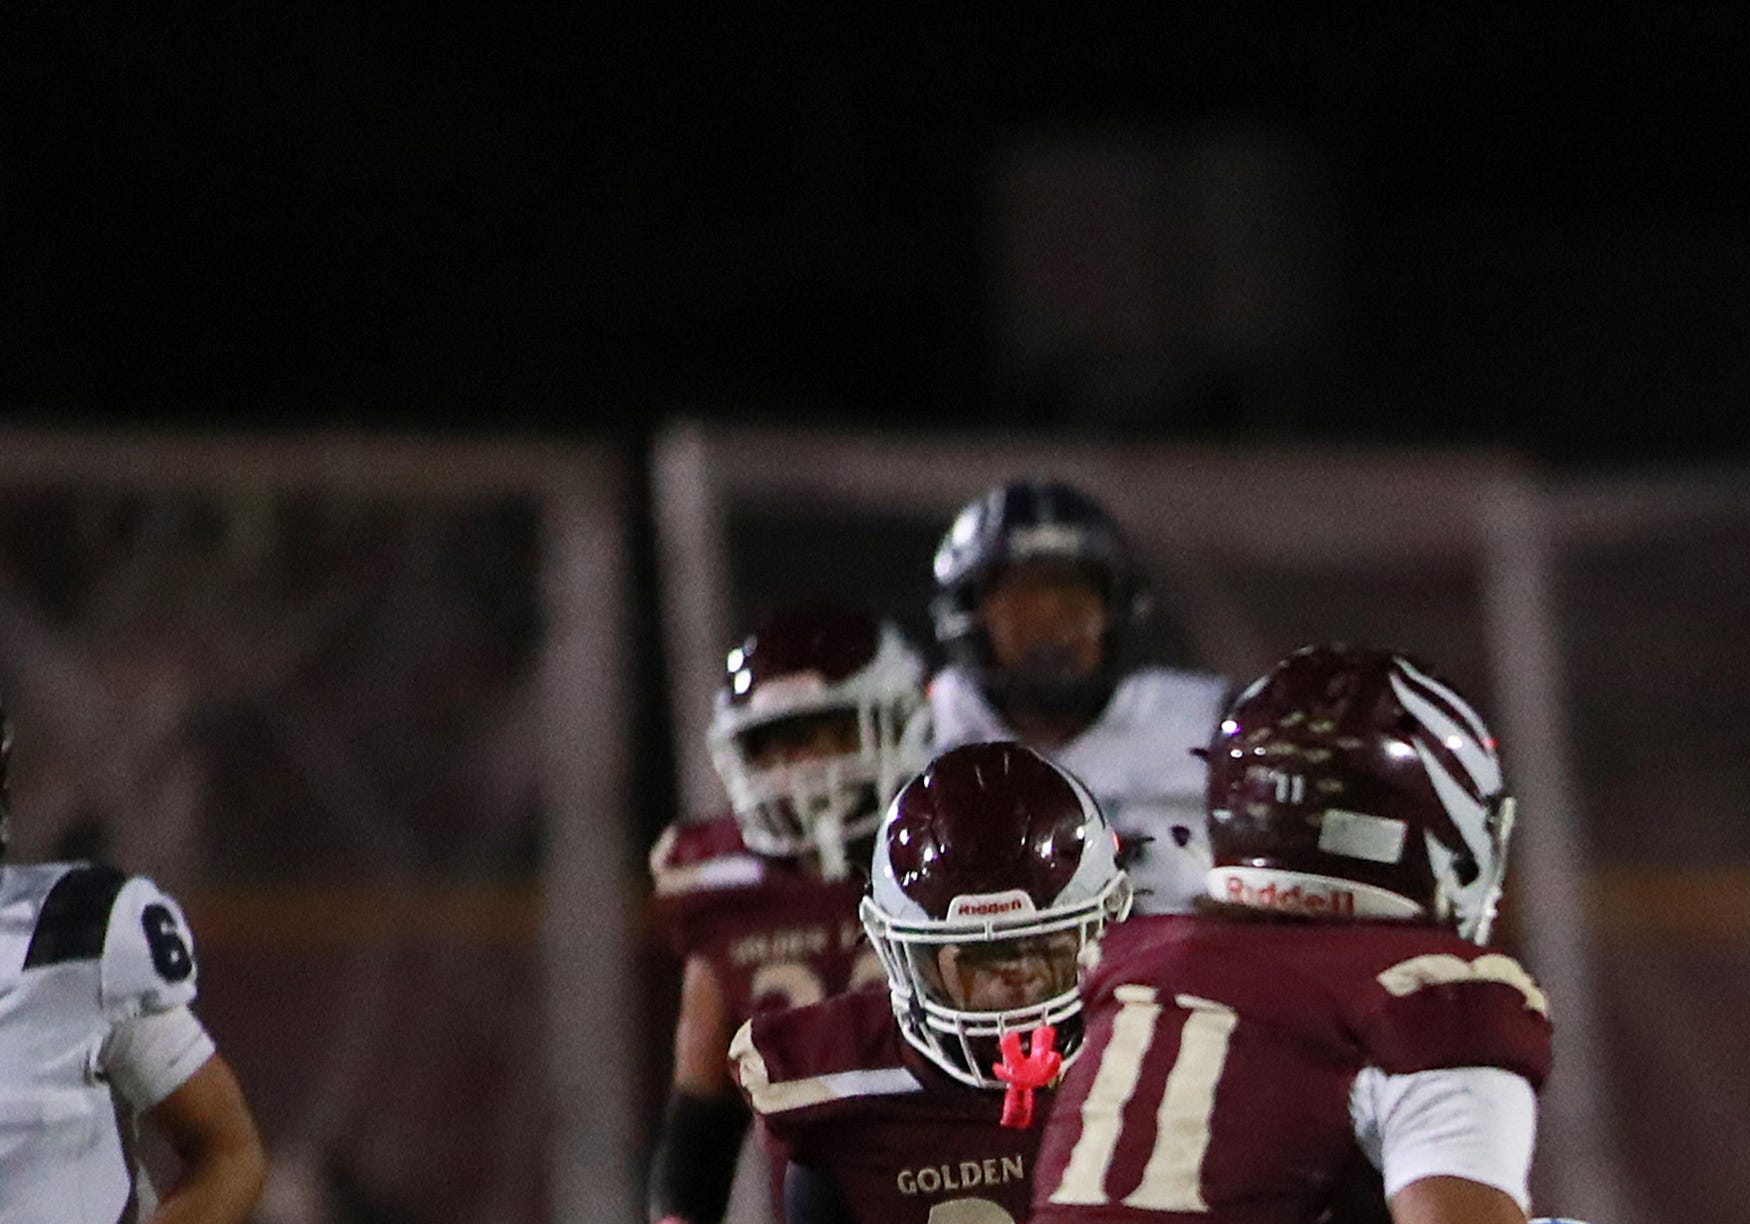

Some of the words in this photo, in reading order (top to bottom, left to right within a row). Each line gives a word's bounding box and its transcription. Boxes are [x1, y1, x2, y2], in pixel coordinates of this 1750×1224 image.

[140, 903, 193, 982] 6
[1048, 983, 1240, 1213] 11
[897, 1155, 1025, 1195] GOLDEN
